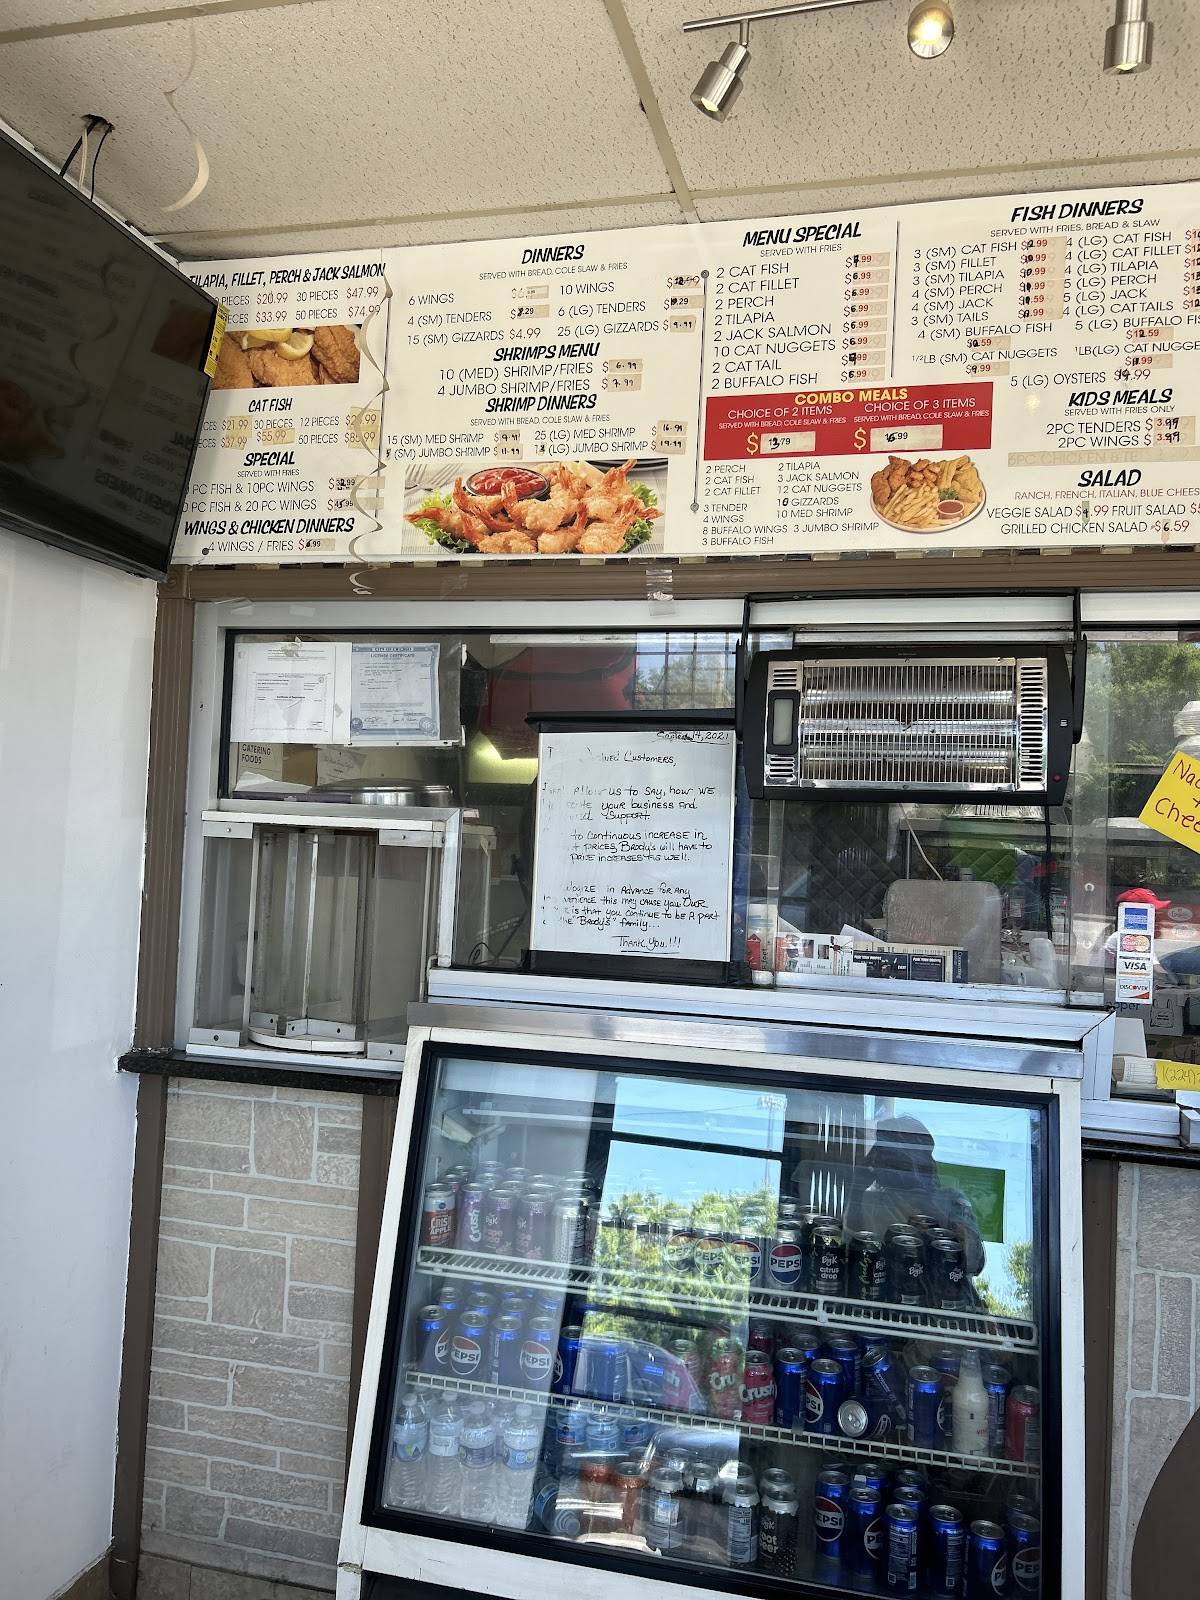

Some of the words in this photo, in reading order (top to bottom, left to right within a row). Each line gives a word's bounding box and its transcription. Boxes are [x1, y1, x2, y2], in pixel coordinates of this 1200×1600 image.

[1011, 204, 1056, 222] FISH
[1057, 198, 1144, 219] DINNERS
[742, 228, 792, 248] MENU
[793, 221, 862, 243] SPECIAL
[521, 245, 585, 265] DINNERS
[1077, 249, 1107, 263] (LG)
[1112, 247, 1139, 258] CAT
[1143, 244, 1182, 256] FILLET
[269, 267, 300, 284] PERCH
[303, 268, 312, 282] &
[312, 266, 339, 282] JACK
[341, 262, 386, 279] SALMON
[958, 269, 1004, 283] TILAPIA
[1111, 273, 1157, 286] PERCH
[560, 284, 573, 296] 10
[575, 281, 615, 295] WINGS
[1110, 288, 1148, 300] JACK
[408, 295, 416, 306] 6
[417, 293, 455, 305] WINGS
[958, 298, 993, 310] JACK
[255, 310, 287, 323] $33.99
[295, 310, 306, 321] 50
[308, 307, 338, 319] PIECES
[558, 306, 565, 317] 6
[568, 304, 593, 319] (LG)
[597, 301, 646, 314] TENDERS
[957, 311, 989, 323] TAILS
[407, 315, 415, 326] 4
[417, 313, 442, 327] (SM)
[446, 311, 492, 325] TENDERS
[714, 330, 721, 342] 2
[726, 328, 763, 341] JACK
[767, 323, 832, 339] SALMON
[965, 324, 1021, 337] BUFFALO
[1025, 322, 1052, 333] FISH
[407, 335, 420, 345] 15
[423, 333, 448, 347] (SM)
[451, 330, 504, 343] GIZZARDS
[509, 328, 541, 341] $4.99
[493, 343, 556, 362] SHRIMPS
[558, 342, 600, 359] MENU
[714, 346, 730, 358] 10
[734, 344, 762, 357] CAT
[766, 339, 836, 355] NUGGETS
[1123, 342, 1149, 354] CAT
[724, 360, 752, 373] CAT
[754, 359, 781, 371] TAIL
[1010, 376, 1018, 387] 5
[1022, 374, 1049, 389] (LG)
[1053, 371, 1106, 385] OYSTERS
[485, 395, 535, 413] SHRIMP
[536, 393, 597, 411] DINNERS
[794, 391, 854, 405] COMBO
[859, 387, 908, 401] MEALS
[1068, 391, 1111, 407] KIDS
[1112, 388, 1173, 405] MEALS
[248, 399, 268, 413] CAT
[269, 397, 293, 411] FISH
[727, 407, 771, 419] CHOICE
[773, 407, 788, 418] OF
[791, 407, 798, 417] 2
[801, 405, 833, 416] ITEMS
[470, 417, 497, 427] SERVED
[498, 416, 515, 426] WITH
[542, 415, 561, 424] COLE
[563, 414, 584, 424] SLAW
[592, 413, 611, 422] FRIES
[310, 433, 338, 444] PIECES
[243, 450, 296, 467] SPECIAL
[237, 468, 262, 478] SERVED
[263, 469, 280, 478] WITH
[282, 468, 300, 477] FRIES
[714, 464, 746, 473] PERCH
[786, 461, 821, 471] TILAPIA
[1077, 468, 1142, 488] SALAD
[713, 486, 734, 496] CAT
[735, 485, 761, 495] FILLET
[777, 484, 789, 494] 12
[791, 484, 811, 493] CAT
[813, 482, 862, 493] NUGGETS
[184, 519, 227, 536] WINGS
[228, 520, 240, 535] &
[240, 519, 295, 535] CHICKEN
[296, 517, 354, 533] DINNERS
[711, 525, 752, 535] BUFFALO
[754, 524, 788, 534] WINGS
[801, 523, 839, 533] JUMBO
[842, 521, 880, 531] SHRIMP
[1000, 523, 1047, 535] GRILLED
[1050, 523, 1105, 534] CHICKEN
[1108, 521, 1148, 533] SALAD
[208, 540, 215, 552] 4
[217, 540, 255, 552] WINGS
[267, 539, 294, 551] FRIES
[710, 536, 751, 546] BUFFALO
[754, 535, 774, 545] FISH
[242, 743, 271, 756] CATERING
[241, 753, 262, 764] FOODS
[1124, 960, 1147, 971] VISA
[816, 1513, 842, 1527] EPSI
